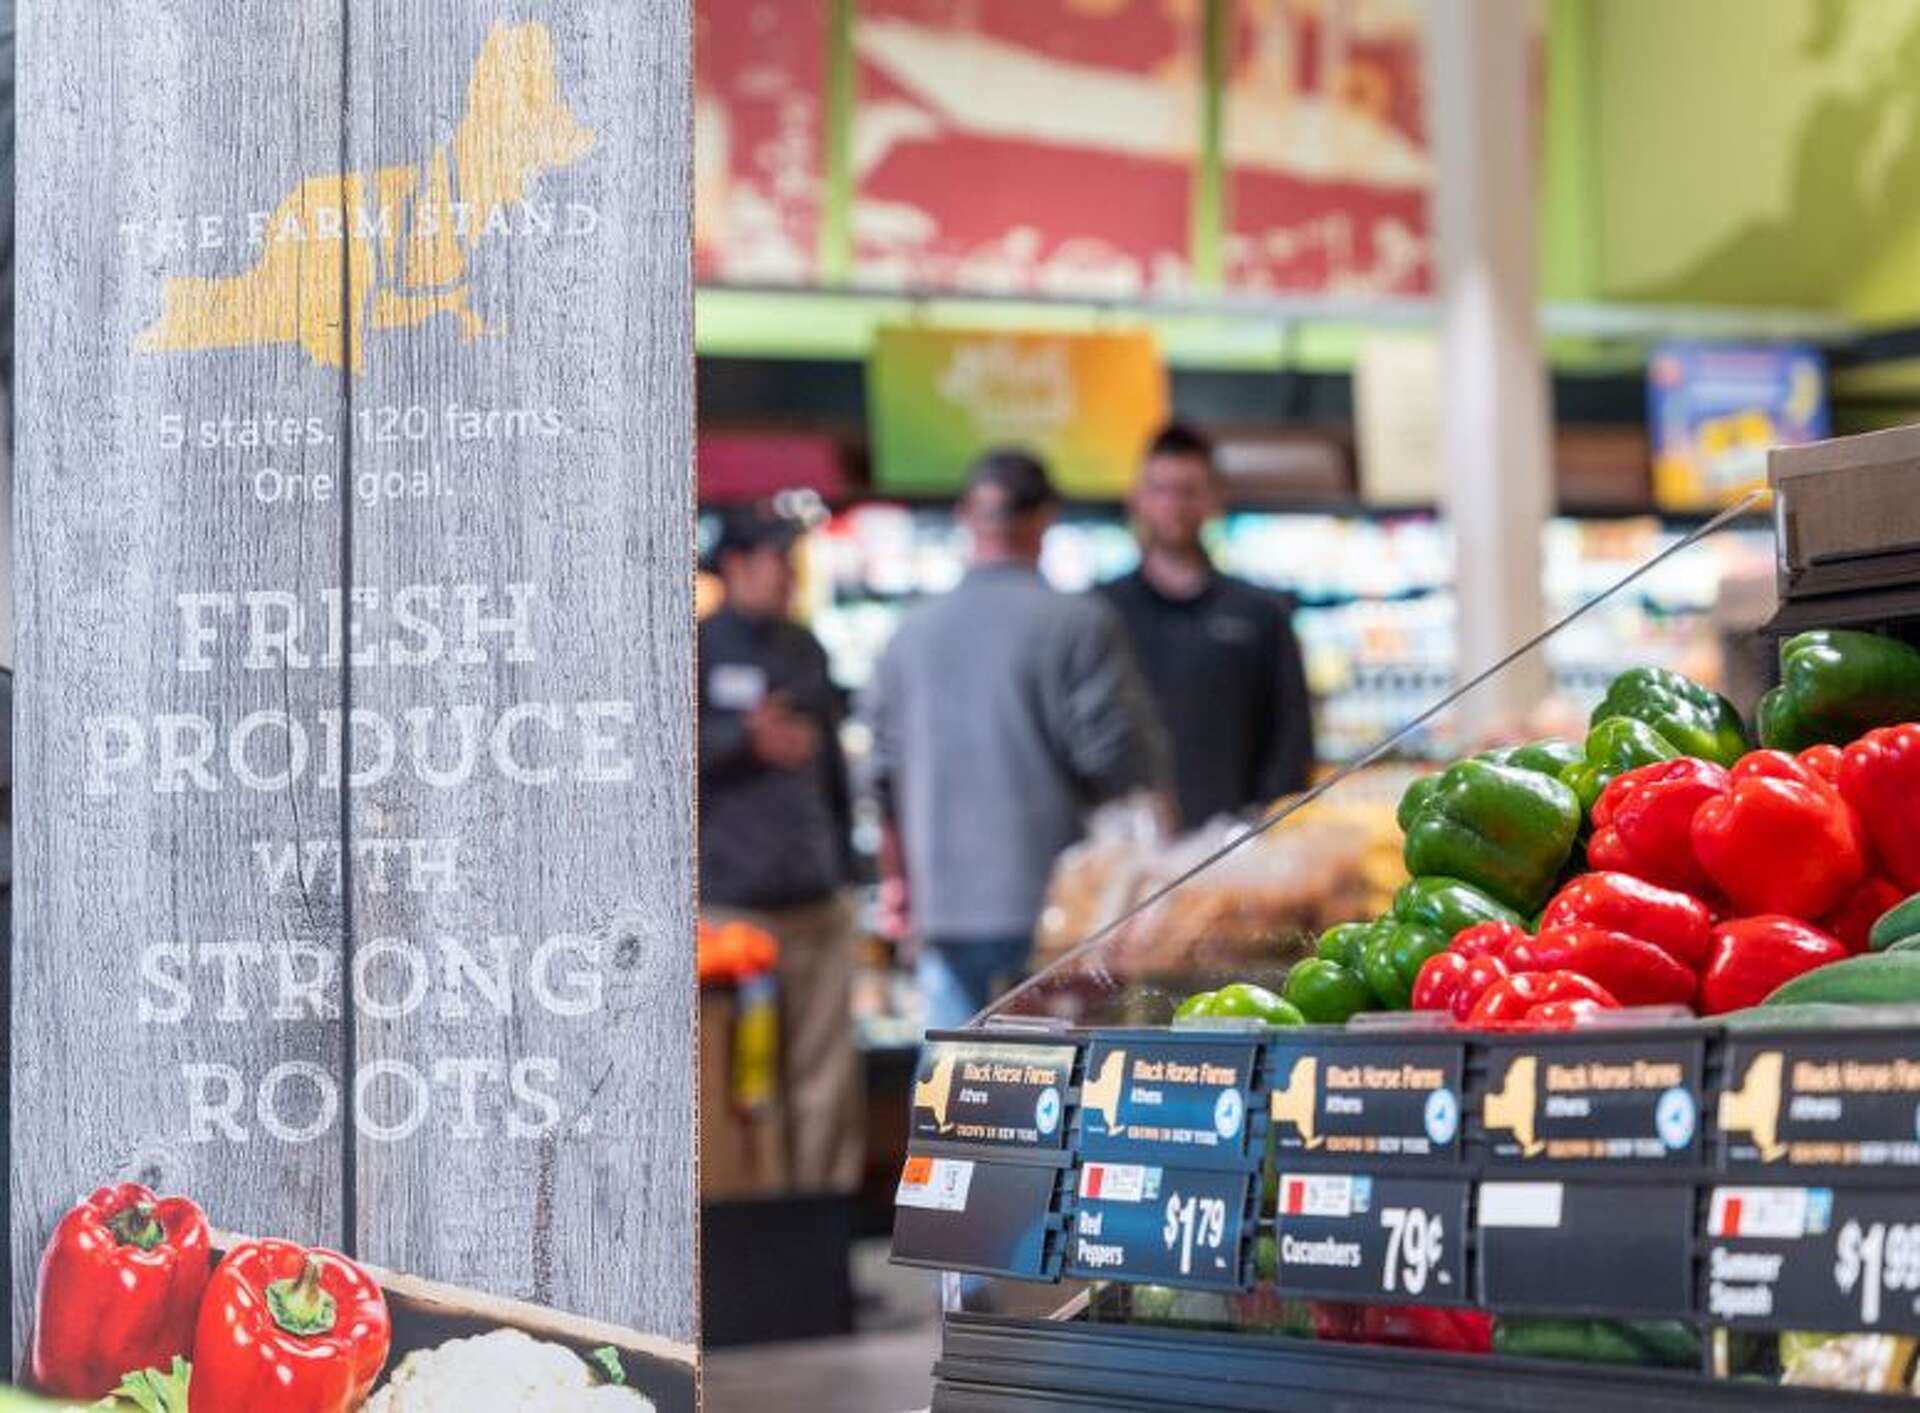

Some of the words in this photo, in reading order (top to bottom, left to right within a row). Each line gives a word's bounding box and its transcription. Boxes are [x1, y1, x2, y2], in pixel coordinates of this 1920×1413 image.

[118, 214, 224, 256] THE
[246, 204, 393, 245] FARM
[417, 199, 598, 238] STAND
[158, 413, 185, 449] 5
[199, 413, 336, 449] states.
[357, 404, 430, 444] 120
[446, 402, 575, 440] farms.
[254, 467, 333, 503] One
[357, 460, 456, 508] goal.
[177, 582, 538, 673] FRESH
[82, 700, 637, 796] PRODUCE
[251, 837, 462, 895] WITH
[137, 931, 602, 1026] STRONG
[181, 1055, 596, 1144] ROOTS.
[992, 1063, 1022, 1083] Horse
[1078, 1238, 1125, 1268] Peppers
[1281, 1233, 1362, 1268] Cucumbers
